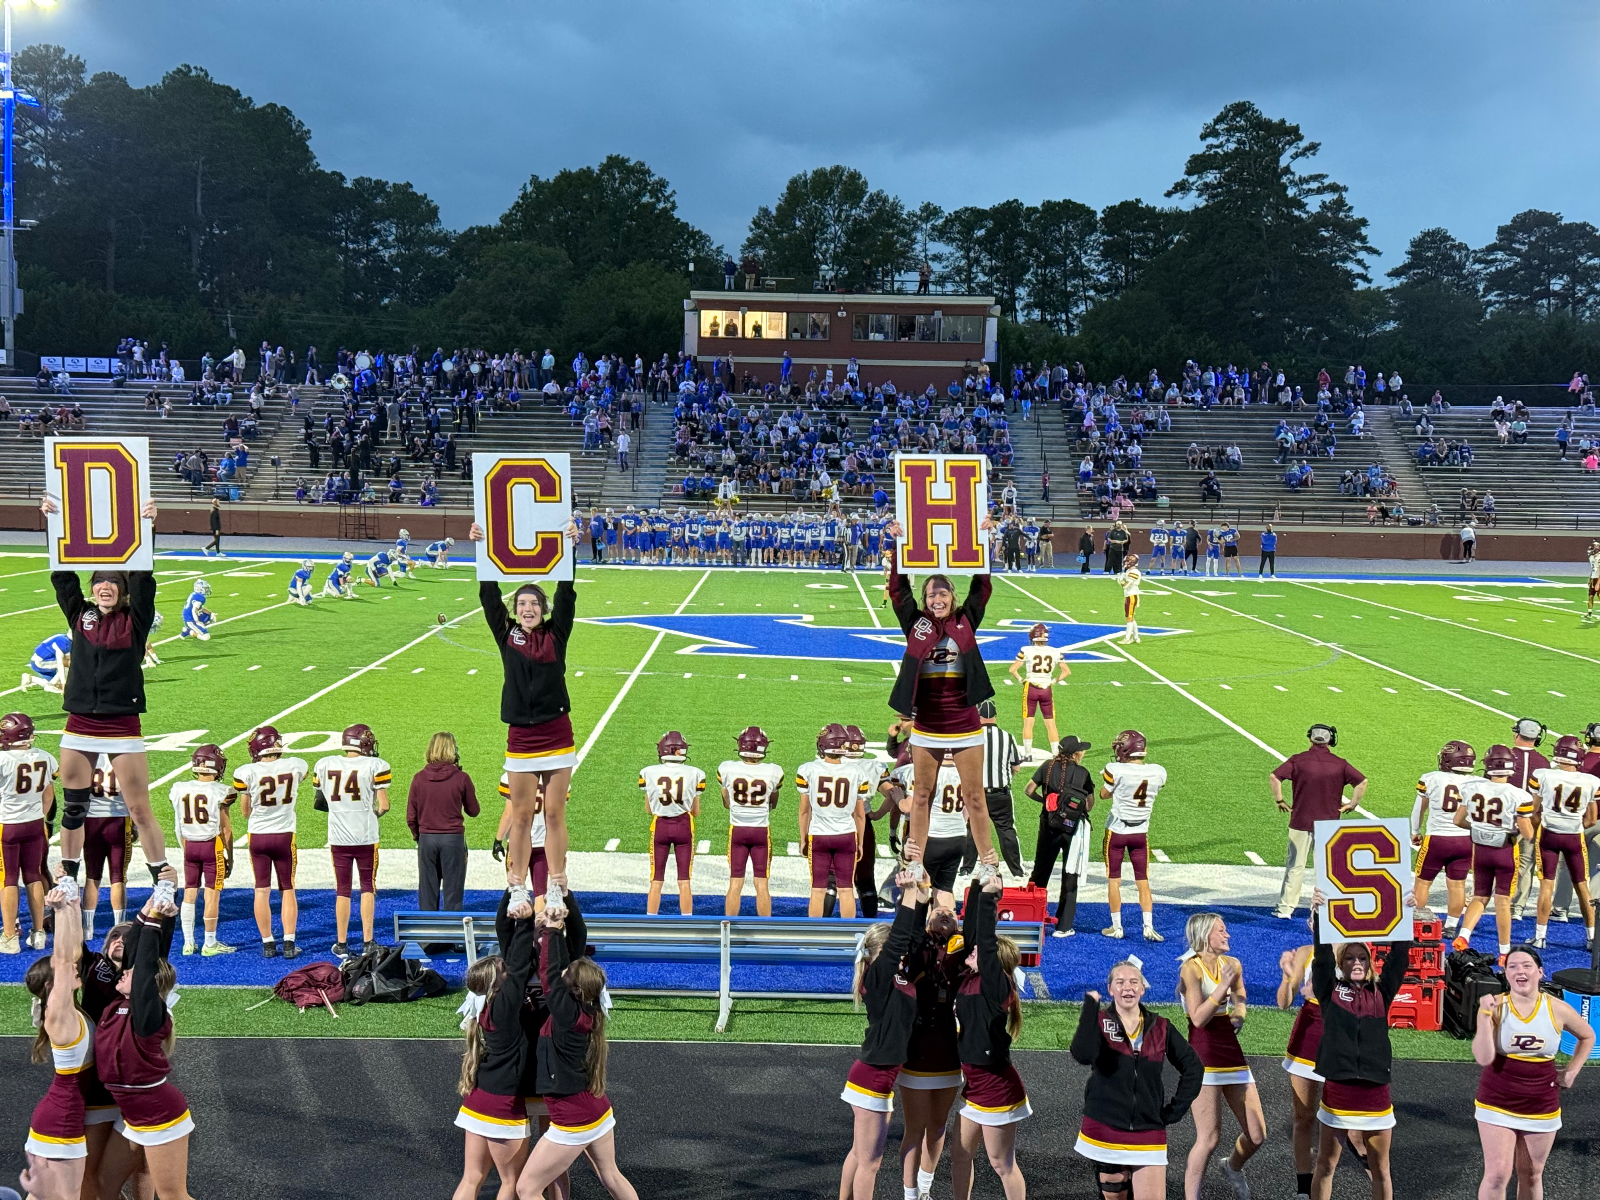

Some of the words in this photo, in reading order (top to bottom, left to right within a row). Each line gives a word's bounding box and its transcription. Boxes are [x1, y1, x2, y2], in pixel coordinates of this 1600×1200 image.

[54, 442, 141, 564] D
[485, 458, 563, 575] C
[900, 459, 985, 567] H
[1032, 654, 1053, 674] 23
[15, 760, 48, 795] 67
[259, 772, 294, 807] 27
[327, 769, 362, 802] 74
[657, 776, 685, 807] 31
[732, 777, 768, 806] 82
[816, 776, 851, 809] 50
[1132, 779, 1149, 808] 4
[182, 793, 210, 825] 16
[1470, 792, 1504, 827] 32
[1551, 783, 1582, 814] 14
[1325, 825, 1403, 938] S
[1509, 1034, 1546, 1051] DC
